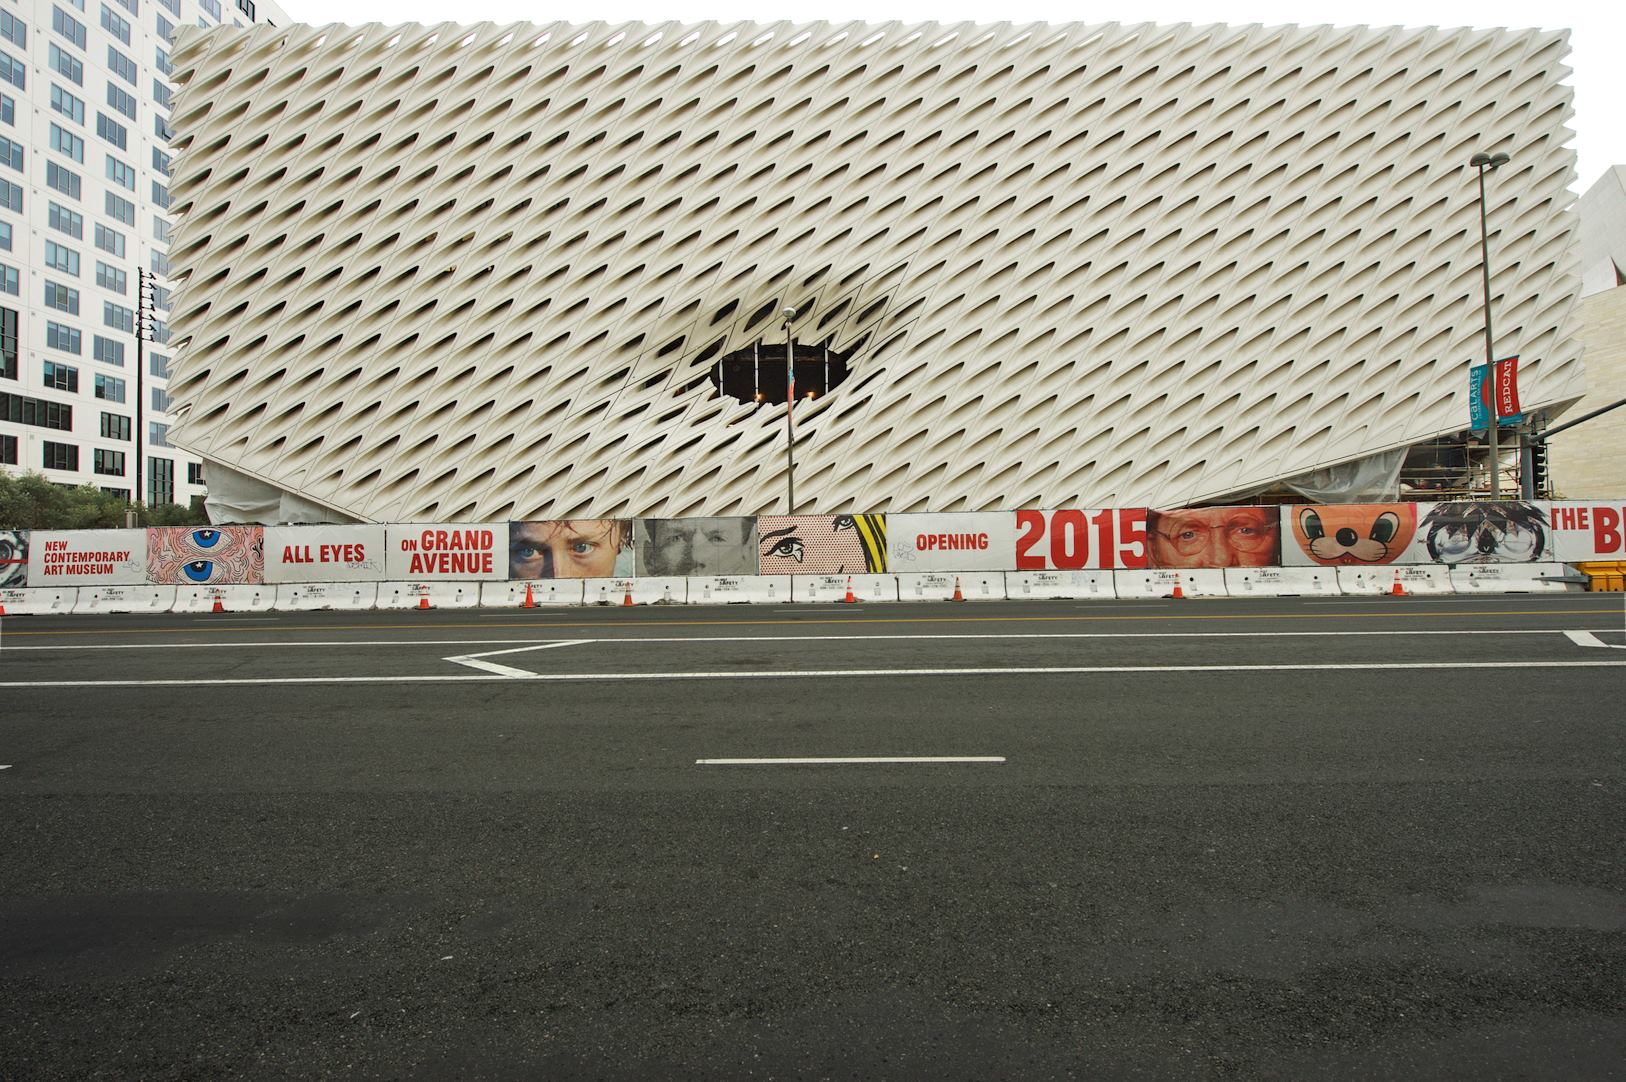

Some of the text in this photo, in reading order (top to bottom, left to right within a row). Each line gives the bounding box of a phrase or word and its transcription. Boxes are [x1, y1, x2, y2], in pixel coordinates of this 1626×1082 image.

[1502, 361, 1513, 413] REDCAT
[401, 530, 493, 551] ON GRAND
[1015, 508, 1148, 571] 2015
[1551, 507, 1626, 554] THE B
[45, 541, 68, 552] NEW
[916, 533, 989, 551] OPENING
[44, 551, 130, 564] CONTEMPORARY
[282, 543, 365, 563] ALL EYES
[409, 552, 493, 574] AVENUE
[44, 564, 64, 576] ART
[66, 564, 114, 575] MUSEUM
